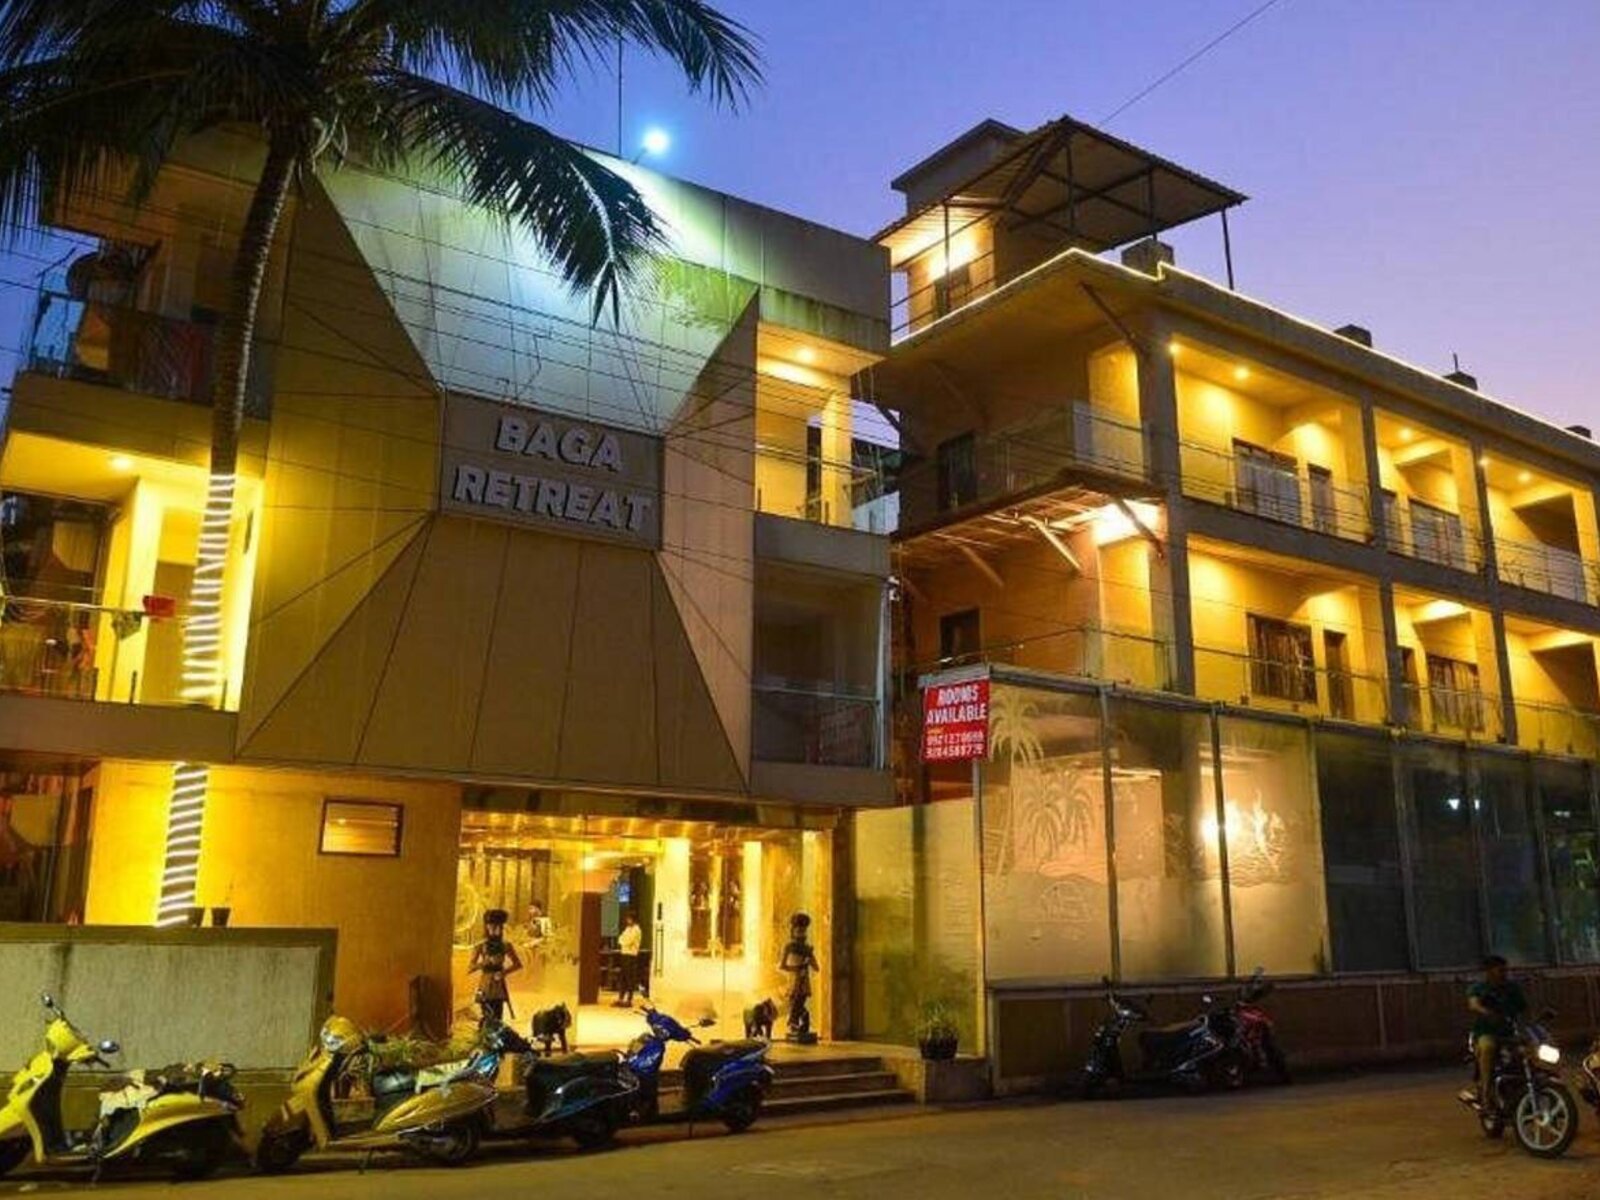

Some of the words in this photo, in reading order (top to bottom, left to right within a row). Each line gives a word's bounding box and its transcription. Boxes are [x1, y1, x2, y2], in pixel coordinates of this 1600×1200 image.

[496, 415, 621, 472] BAGA
[453, 465, 650, 531] RETREAT
[926, 703, 987, 725] AVAILABLE
[937, 685, 979, 706] ROOMS
